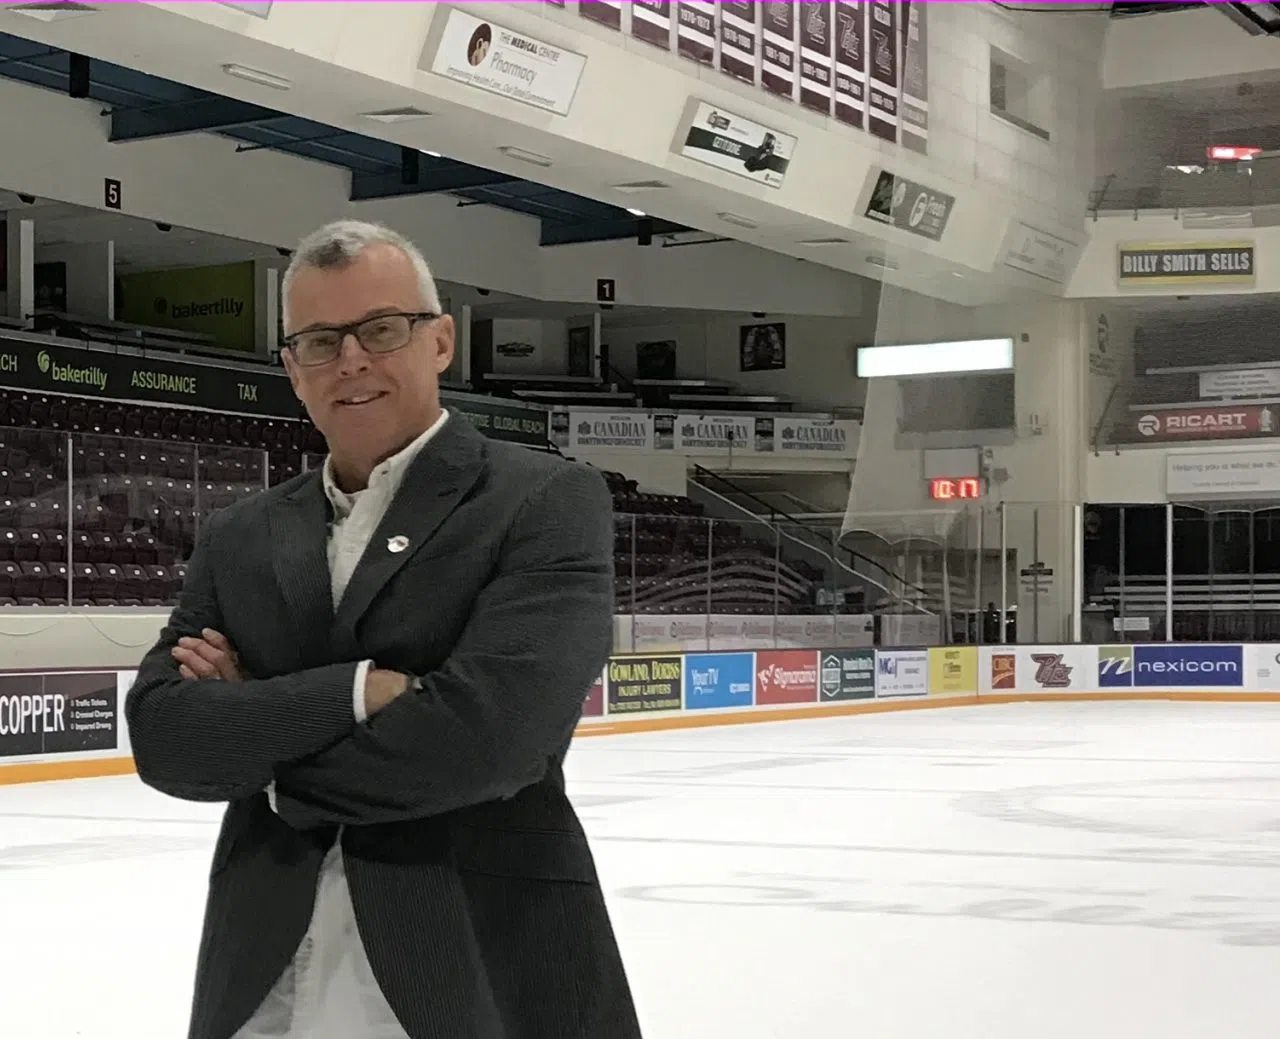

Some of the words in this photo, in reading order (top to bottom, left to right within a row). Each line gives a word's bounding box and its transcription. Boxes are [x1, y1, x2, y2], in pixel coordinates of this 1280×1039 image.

[511, 37, 538, 54] MEDICAL
[538, 47, 560, 62] CENTRE
[490, 51, 537, 86] Pharmacy
[108, 184, 117, 204] 5
[1123, 255, 1158, 273] BILLY
[1162, 253, 1206, 272] SMITH
[1211, 252, 1250, 270] SELLS
[602, 283, 610, 298] 1
[172, 297, 244, 318] bakertilly
[52, 362, 108, 390] bakertilly
[131, 370, 196, 394] ASSURANCE
[237, 383, 258, 402] TAX
[594, 421, 646, 437] CANADIAN
[1166, 413, 1247, 427] RICART
[796, 426, 846, 441] CANADIAN
[933, 479, 979, 499] 10:17
[1138, 659, 1237, 672] nexicom
[618, 685, 641, 697] INJURY
[643, 684, 672, 695] LAWYERS
